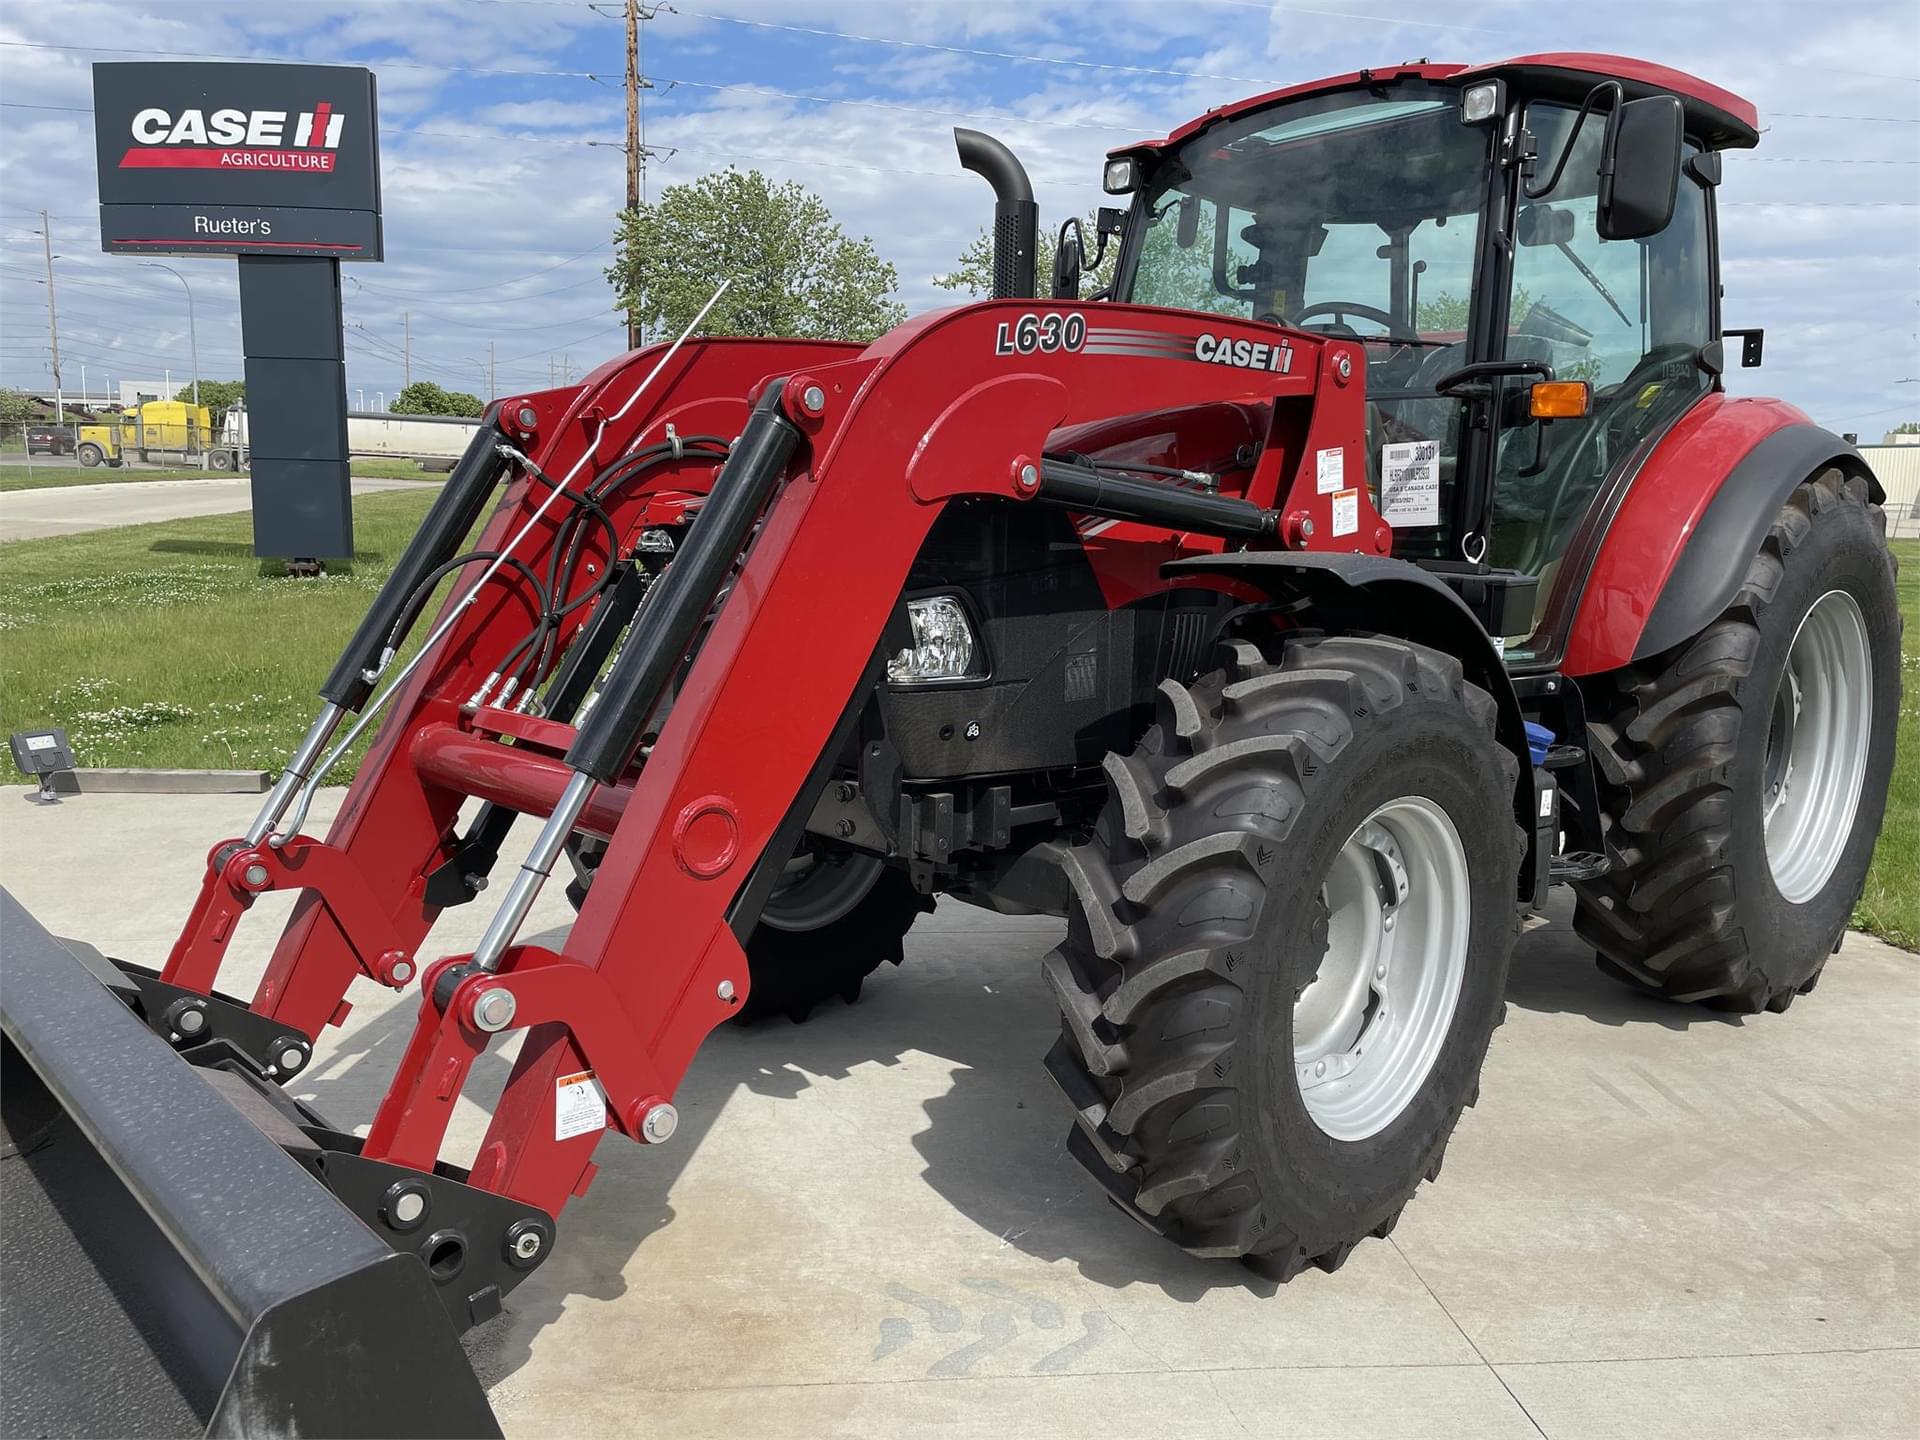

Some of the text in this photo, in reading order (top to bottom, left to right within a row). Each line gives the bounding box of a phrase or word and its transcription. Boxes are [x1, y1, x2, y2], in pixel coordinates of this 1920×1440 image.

[131, 108, 287, 146] CASE
[220, 152, 330, 169] AGRICULTURE
[194, 215, 272, 235] Rueter's
[995, 312, 1086, 355] L630
[1195, 333, 1270, 369] CASE
[1404, 484, 1424, 492] CANADA
